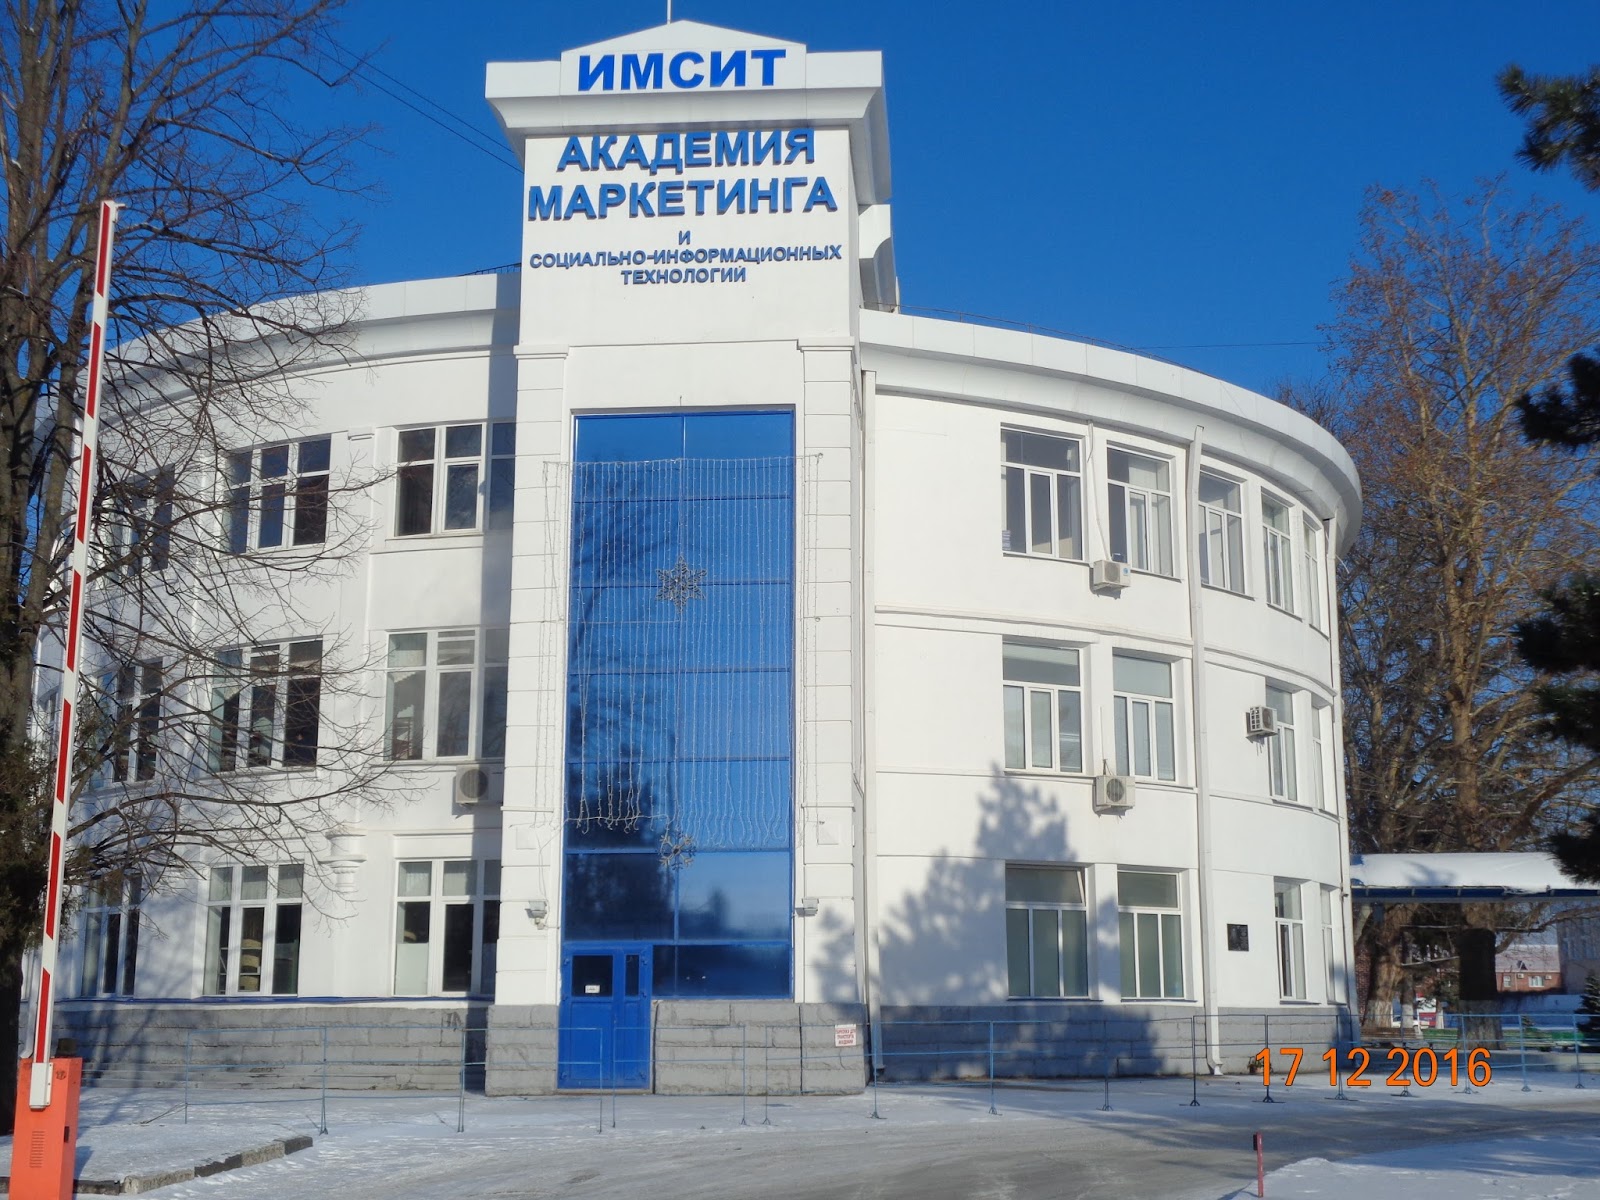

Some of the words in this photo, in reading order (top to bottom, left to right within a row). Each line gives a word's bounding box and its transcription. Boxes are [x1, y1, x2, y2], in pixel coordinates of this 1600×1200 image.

[578, 49, 787, 92] ИМСИТ
[557, 127, 816, 176] АКАДЕМИЯ
[528, 176, 839, 221] МАРКЕТИНГА
[529, 244, 842, 270] СОЦИАЛЬНО-ИНФОРМАЦИОННЫХ
[678, 230, 691, 246] И
